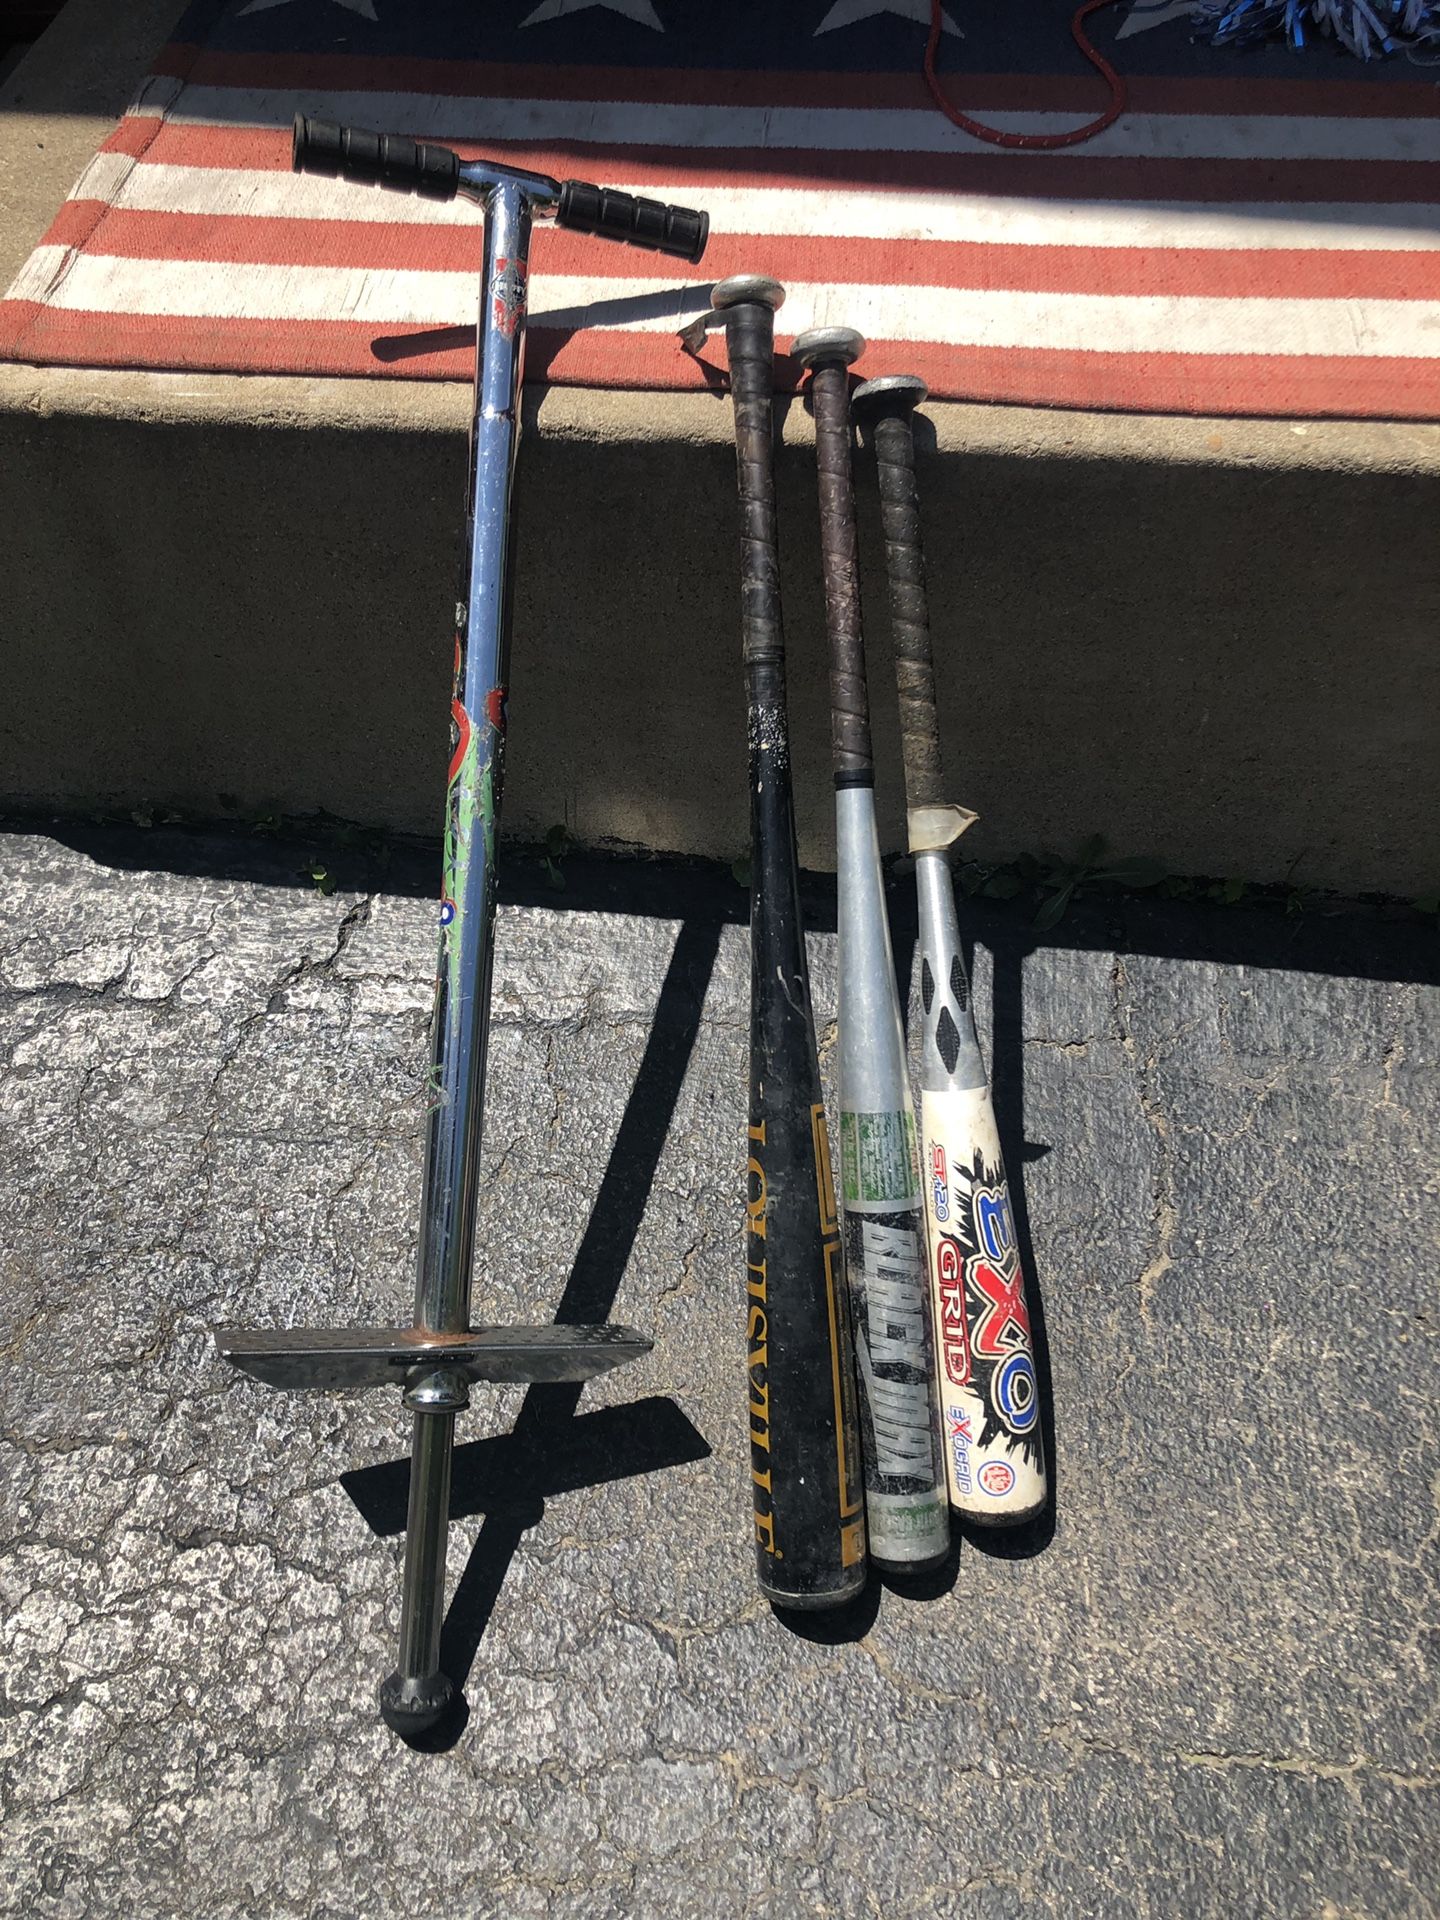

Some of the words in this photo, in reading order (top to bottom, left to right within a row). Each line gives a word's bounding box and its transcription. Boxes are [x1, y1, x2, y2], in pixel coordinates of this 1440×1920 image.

[862, 1220, 927, 1372] BLACK
[938, 1240, 970, 1386] GRID
[970, 1187, 1040, 1431] EXO
[870, 1374, 935, 1482] MAX
[947, 1405, 973, 1495] EXOGRID
